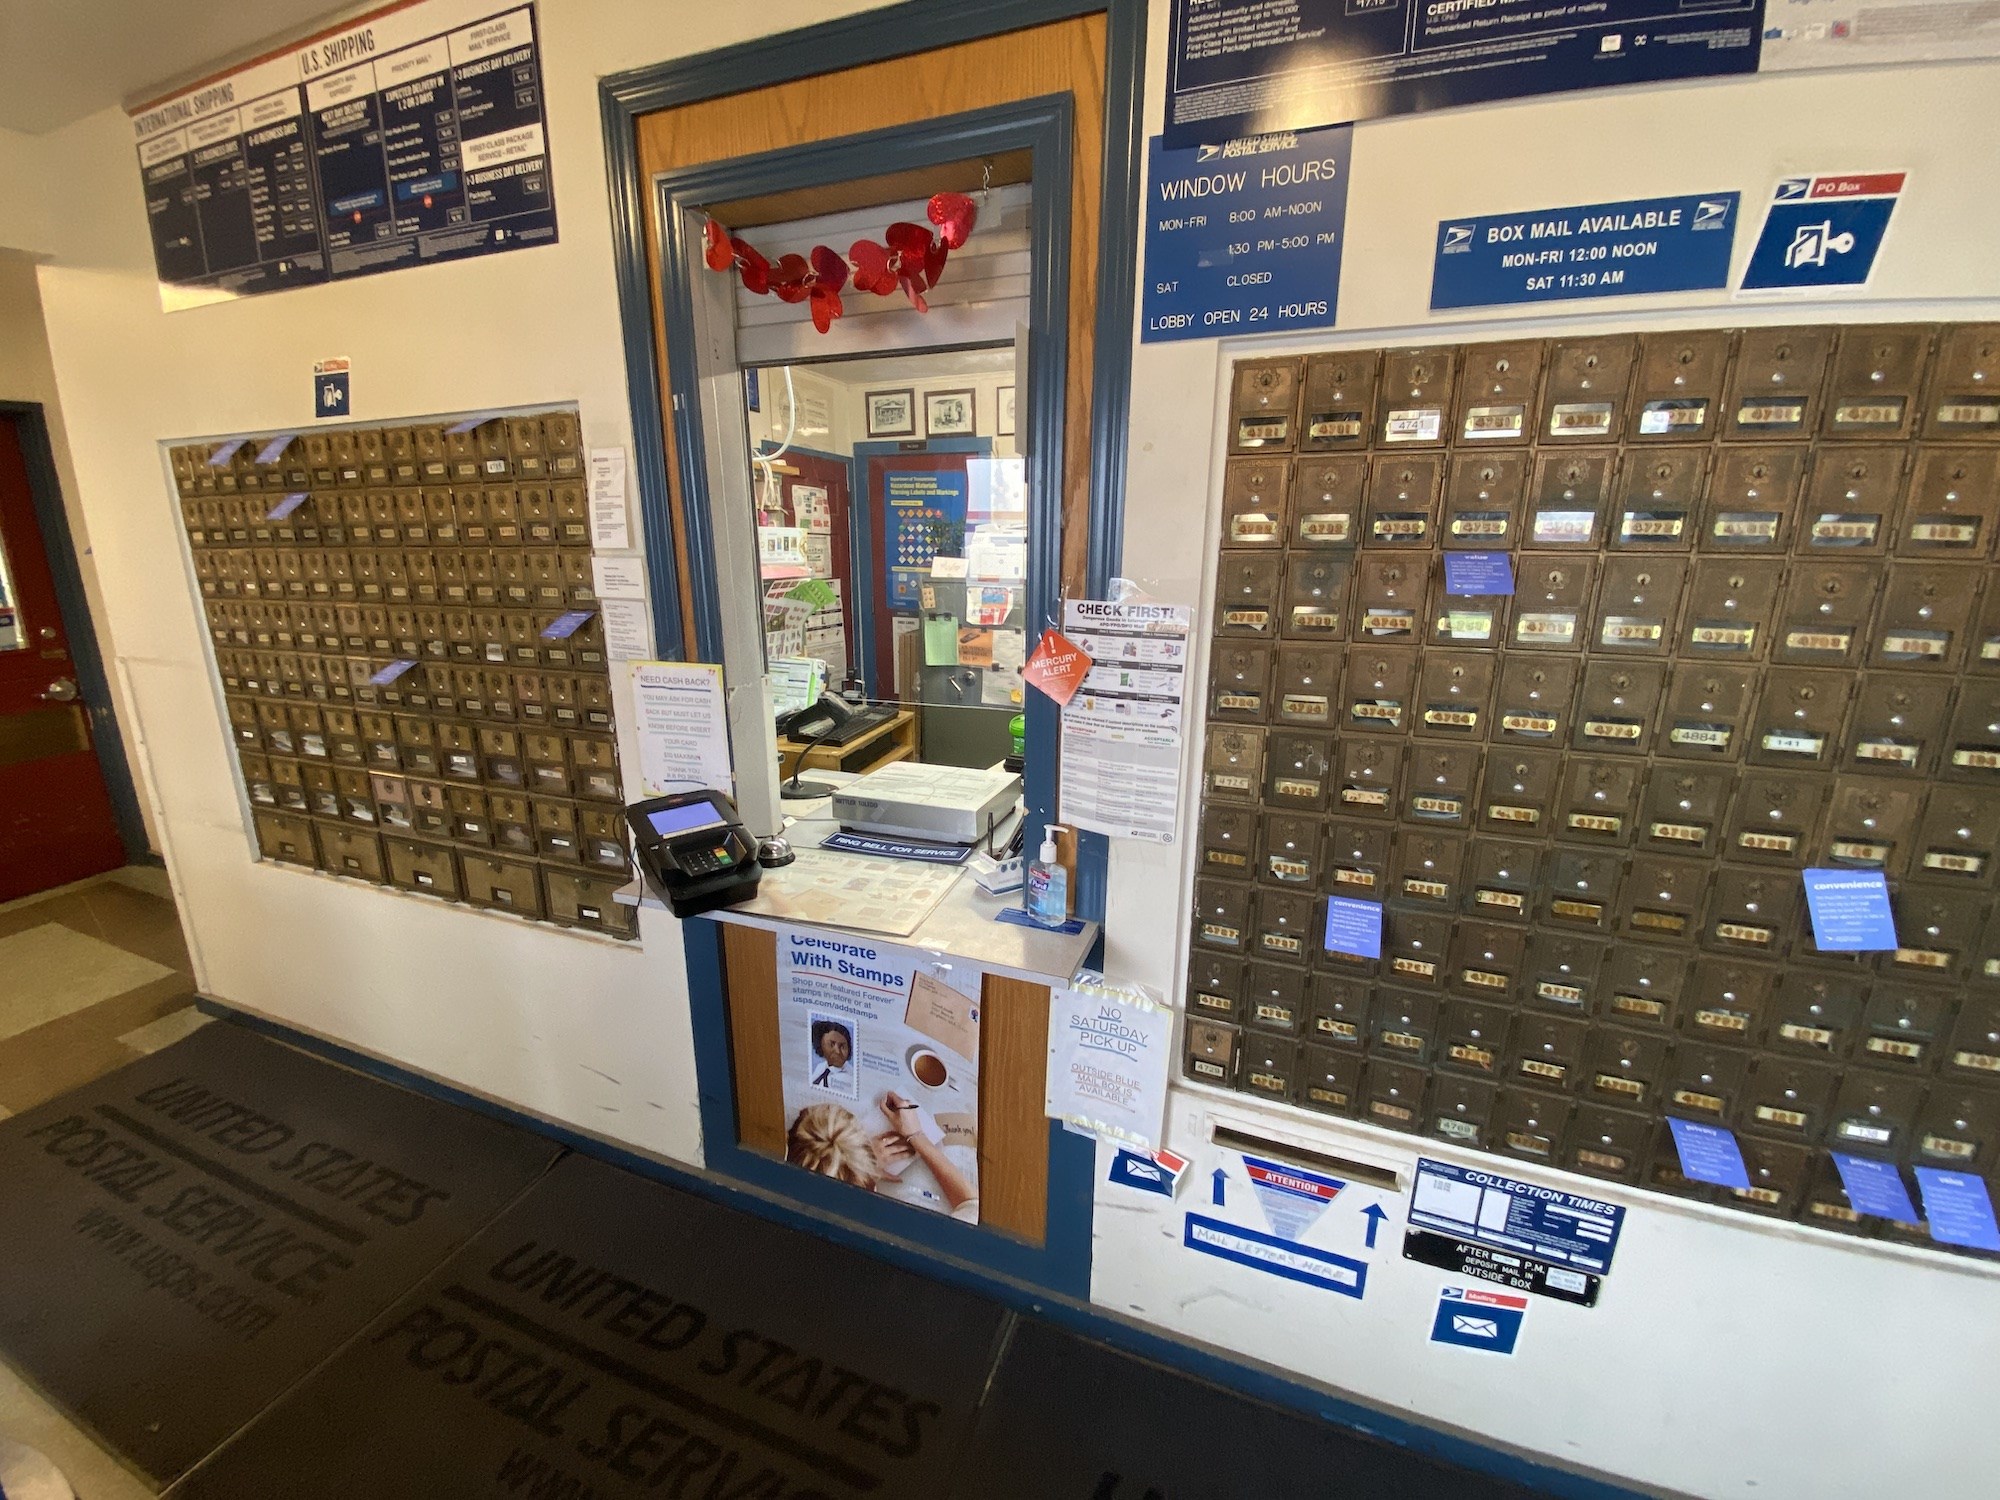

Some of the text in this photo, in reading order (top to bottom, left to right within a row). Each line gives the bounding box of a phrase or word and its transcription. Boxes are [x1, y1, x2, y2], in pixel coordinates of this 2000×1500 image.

[1188, 4, 1263, 24] Additional security and
[1220, 10, 1271, 28] coverage up to
[1425, 2, 1607, 35] Postmarked Return Receipt as proof of mailing
[1187, 16, 1301, 43] Available with limited indemnity for
[1222, 36, 1237, 45] Mail
[1284, 25, 1299, 33] and
[302, 29, 374, 74] U.S. SHIPPING
[1222, 43, 1251, 56] Package
[1252, 33, 1295, 48] International
[503, 50, 531, 67] DELIVERY
[134, 101, 193, 137] INTERNATIONAL
[194, 83, 234, 114] SHIPPING
[1222, 137, 1299, 159] POSTAL SERVICE
[1225, 136, 1262, 149] UNITED
[475, 159, 543, 185] BUSINESS DAY DELIVERY
[1161, 159, 1336, 201] WINDOW HOURS
[1816, 182, 1835, 193] PO
[1159, 201, 1322, 231] MON-FRI 8:00 AM-NOON
[1487, 209, 1682, 244] BOX MAIL AVAILABLE
[1228, 232, 1335, 255] 1:30 PM-5:00 PM
[1502, 241, 1657, 268] MON-FRI 12:00 NOON
[1156, 271, 1272, 294] SAT CLOSED
[1526, 270, 1624, 291] SAT 11:30 AM
[1150, 301, 1328, 331] LOBBY OPEN 24 HOURS
[1399, 420, 1424, 429] 4741
[1077, 603, 1175, 619] CHECK FIRST!
[1031, 652, 1077, 670] MERCURY
[1042, 664, 1072, 677] ALERT
[640, 675, 711, 687] NEED CASH BACK?
[643, 694, 655, 702] YOU
[645, 708, 660, 716] BACK
[648, 723, 665, 731] KNOW
[666, 724, 688, 732] BEFORE
[1682, 731, 1717, 742] 4884
[664, 738, 679, 746] YOUR
[835, 837, 960, 857] RING BELL FOR SERVICE
[1813, 880, 1883, 891] convenience
[1334, 899, 1380, 913] convenience
[791, 935, 877, 960] Celebrate
[791, 951, 904, 987] With Stamps
[792, 977, 861, 998] Shop our featured
[792, 987, 822, 998] stamps
[823, 991, 852, 1005] in-store
[865, 1001, 872, 1009] at
[792, 996, 878, 1020] usps.com/addstamps
[1100, 1005, 1122, 1020] NO
[1071, 1015, 1149, 1044] SATURDAY
[1080, 1032, 1138, 1053] PICK UP
[1071, 1063, 1140, 1088] OUTSIDE BLUE
[1198, 1064, 1221, 1075] 4729
[1077, 1074, 1133, 1096] MAIL BOX IS
[1078, 1084, 1129, 1106] AVAILABLE
[136, 1080, 451, 1226] UNITED STATES
[1264, 1172, 1319, 1194] ATTENTION
[1465, 1171, 1616, 1216] COLLECTION TIMES
[23, 1113, 355, 1298] POSTAL SERVICE
[1196, 1228, 1344, 1280] MAIL LETTERS HERE
[1456, 1243, 1545, 1275] AFTER P.M.
[1462, 1265, 1505, 1284] OUTSIDE
[1510, 1278, 1532, 1290] BOX
[1465, 1257, 1498, 1271] DEPOSIT
[1501, 1265, 1520, 1278] MAIL
[1524, 1272, 1534, 1280] IN
[1468, 1293, 1497, 1304] Mailing
[490, 1240, 943, 1458] UNITED STATES
[371, 1305, 588, 1440] POSTAL
